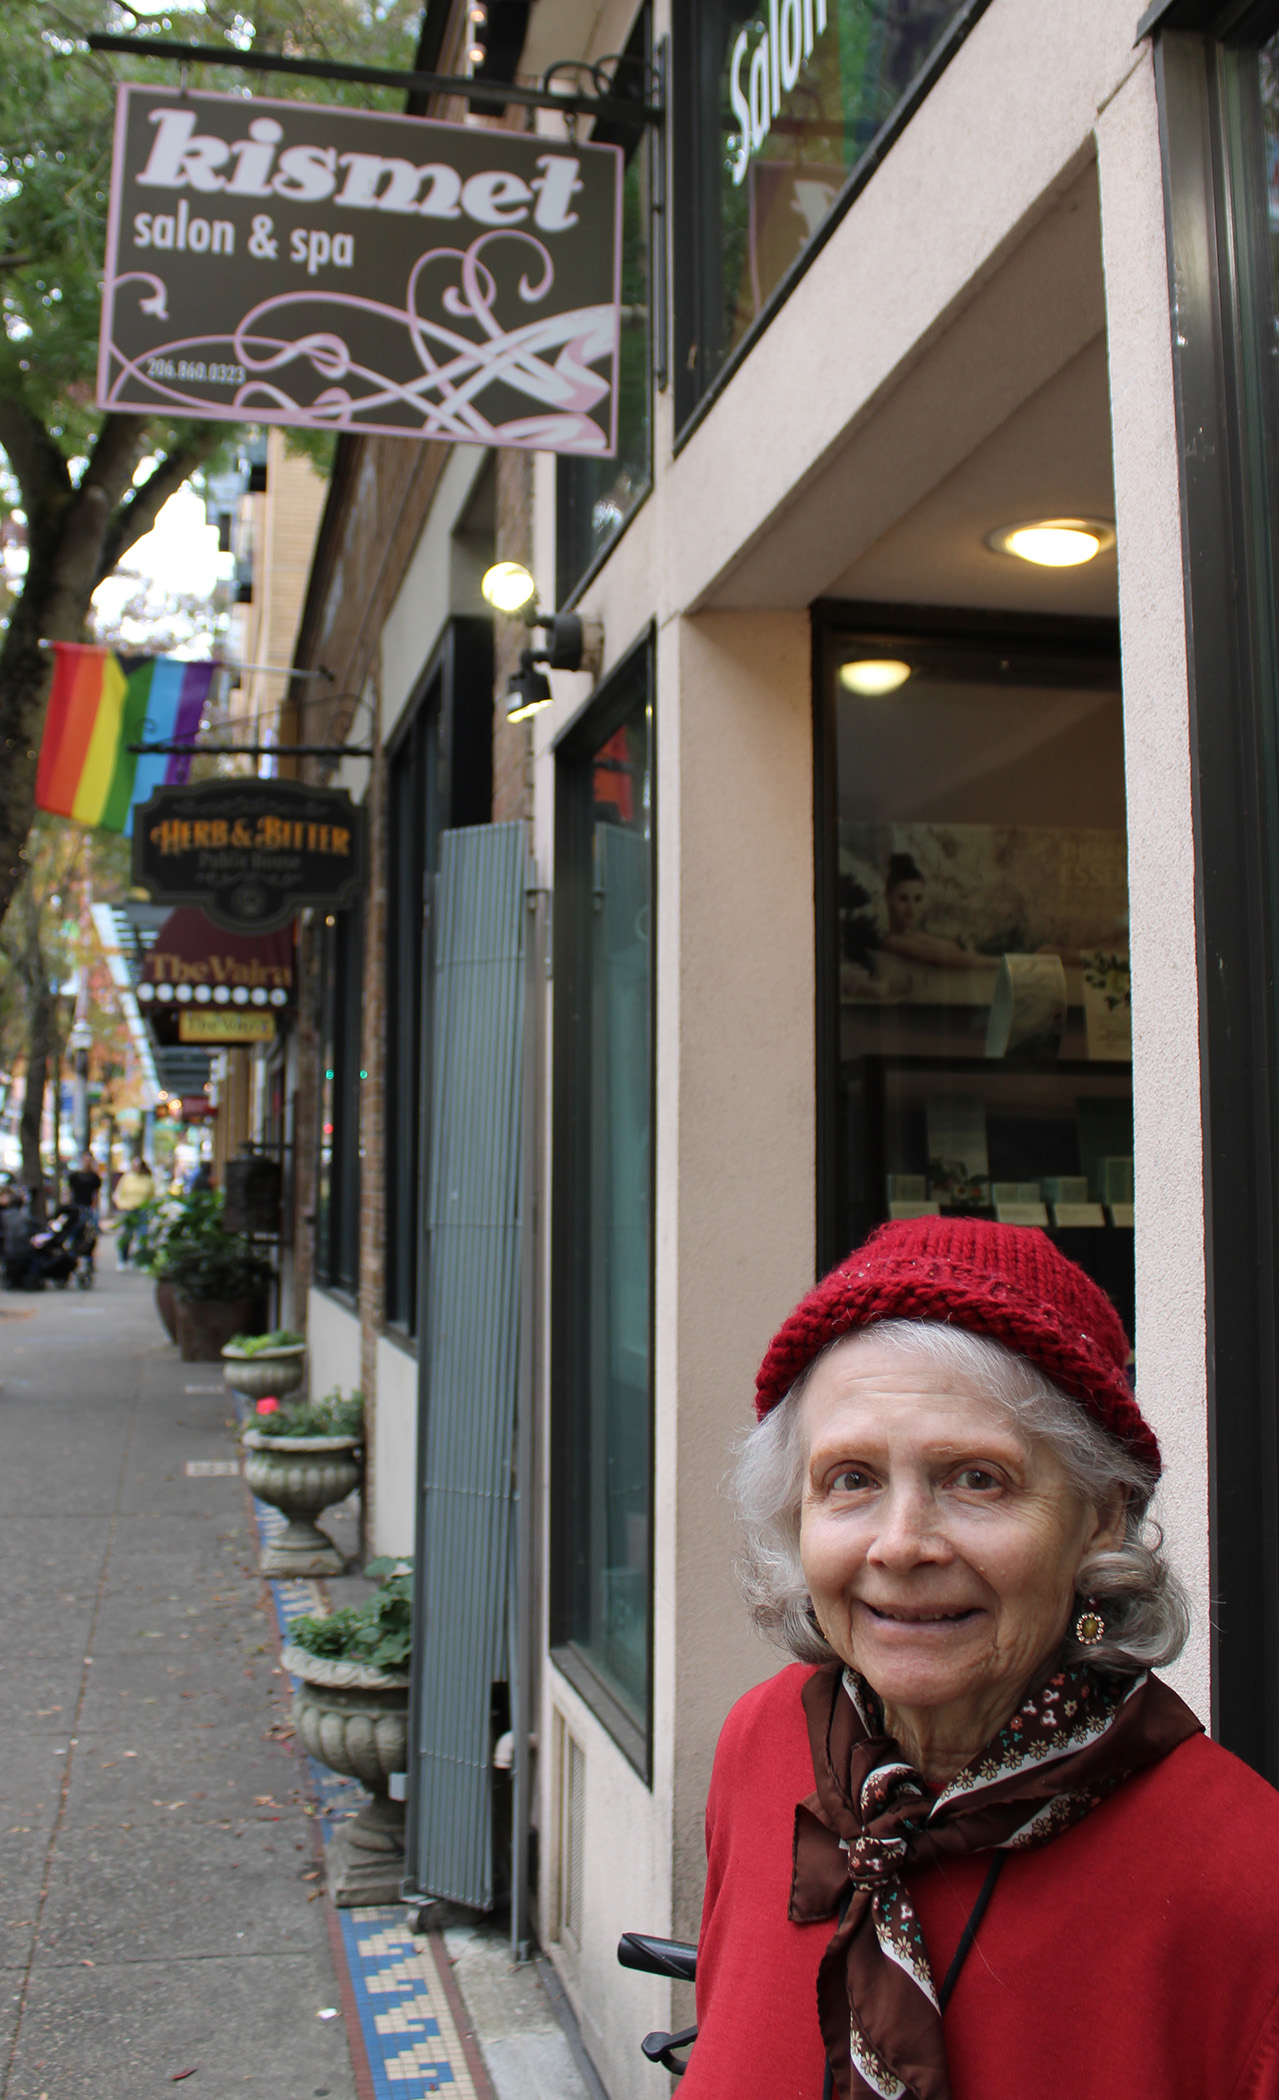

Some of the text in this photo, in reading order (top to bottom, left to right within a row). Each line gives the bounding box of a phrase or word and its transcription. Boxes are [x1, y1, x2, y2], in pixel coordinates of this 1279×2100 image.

[136, 107, 583, 232] kismet
[134, 199, 354, 274] salon & spa
[147, 357, 247, 385] 206.860.0323
[230, 816, 253, 849] &
